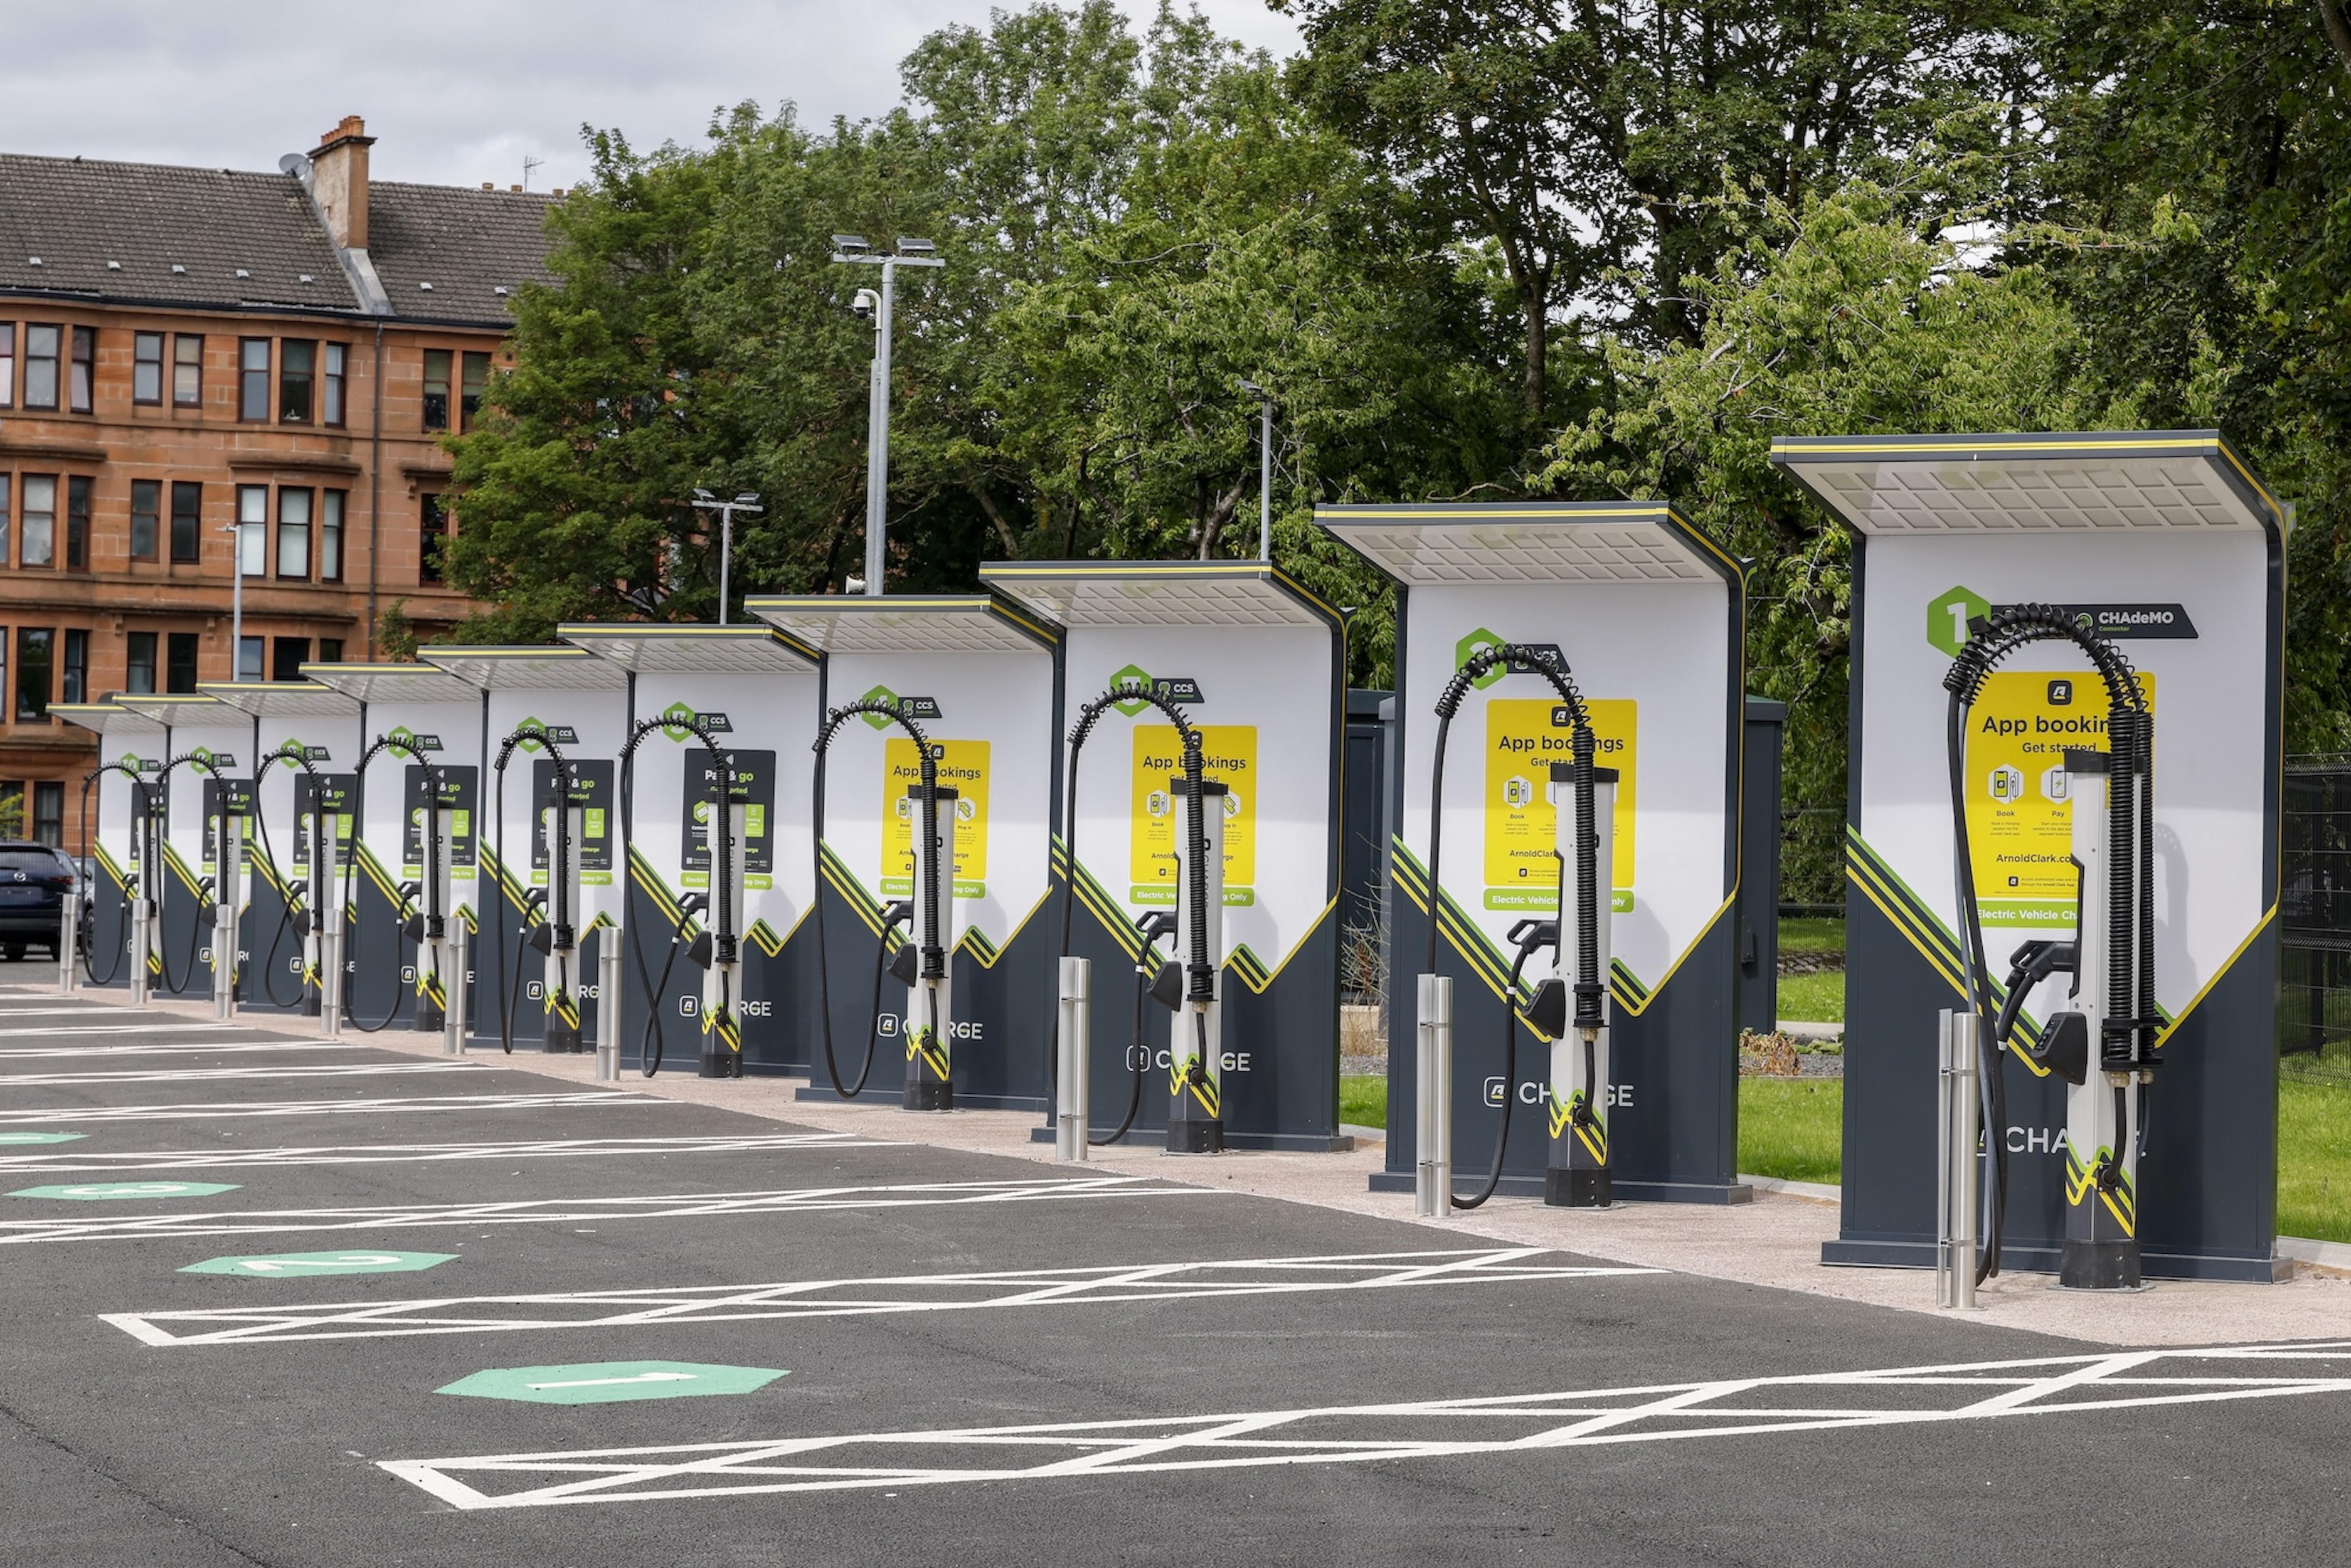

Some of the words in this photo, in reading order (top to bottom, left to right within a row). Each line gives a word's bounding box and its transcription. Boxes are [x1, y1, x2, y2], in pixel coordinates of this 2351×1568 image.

[1947, 602, 1967, 644] 1
[2098, 612, 2174, 625] CHAdeMO
[1174, 683, 1194, 692] CCS
[916, 701, 933, 710] CCS
[1982, 716, 2027, 736] App
[2036, 716, 2110, 733] bookin
[1499, 736, 1535, 753] App
[1542, 736, 1624, 753] boongs
[2022, 743, 2045, 752] Get
[1143, 756, 1173, 770] App
[1531, 758, 1549, 766] Get
[704, 770, 717, 781] Pa
[729, 770, 736, 781] &
[738, 773, 754, 783] go
[893, 765, 918, 778] App
[936, 766, 981, 780] ookings
[439, 782, 447, 792] &
[448, 784, 461, 792] go
[571, 778, 580, 788] &
[581, 780, 595, 789] go
[239, 794, 250, 802] go
[326, 789, 332, 797] &
[1996, 854, 2071, 863] ArnoldClark.co
[1229, 894, 1247, 902] Only
[1492, 895, 1525, 904] Electric
[1528, 896, 1558, 904] Vehicle
[1611, 898, 1625, 907] nly
[1978, 909, 2016, 919] Electric
[2019, 909, 2058, 919] Vehicle
[740, 1000, 772, 1016] RGE
[1155, 1049, 1251, 1071] CGE
[1519, 1081, 1634, 1107] CHE
